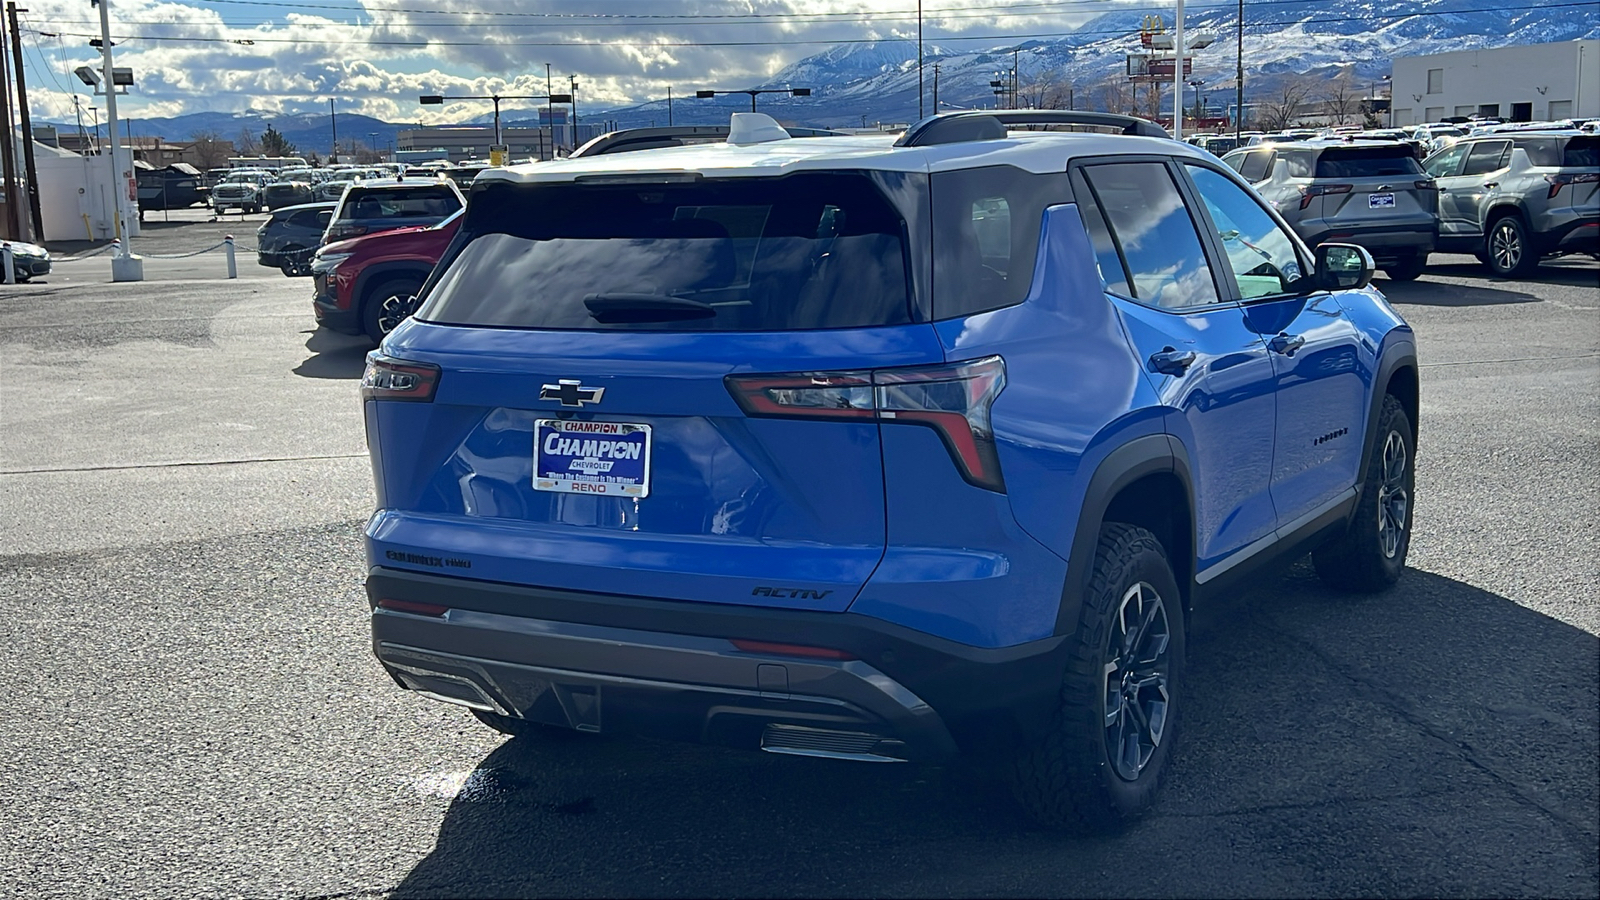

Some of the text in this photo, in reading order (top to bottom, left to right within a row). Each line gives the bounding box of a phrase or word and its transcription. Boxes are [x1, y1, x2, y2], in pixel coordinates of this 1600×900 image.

[565, 422, 618, 433] CHAMPION
[544, 433, 642, 460] CHAMPION
[572, 461, 610, 470] CHEVROLET
[565, 472, 574, 480] The
[575, 473, 599, 482] Customer
[572, 482, 606, 493] RENO
[751, 586, 834, 600] ACTIV
